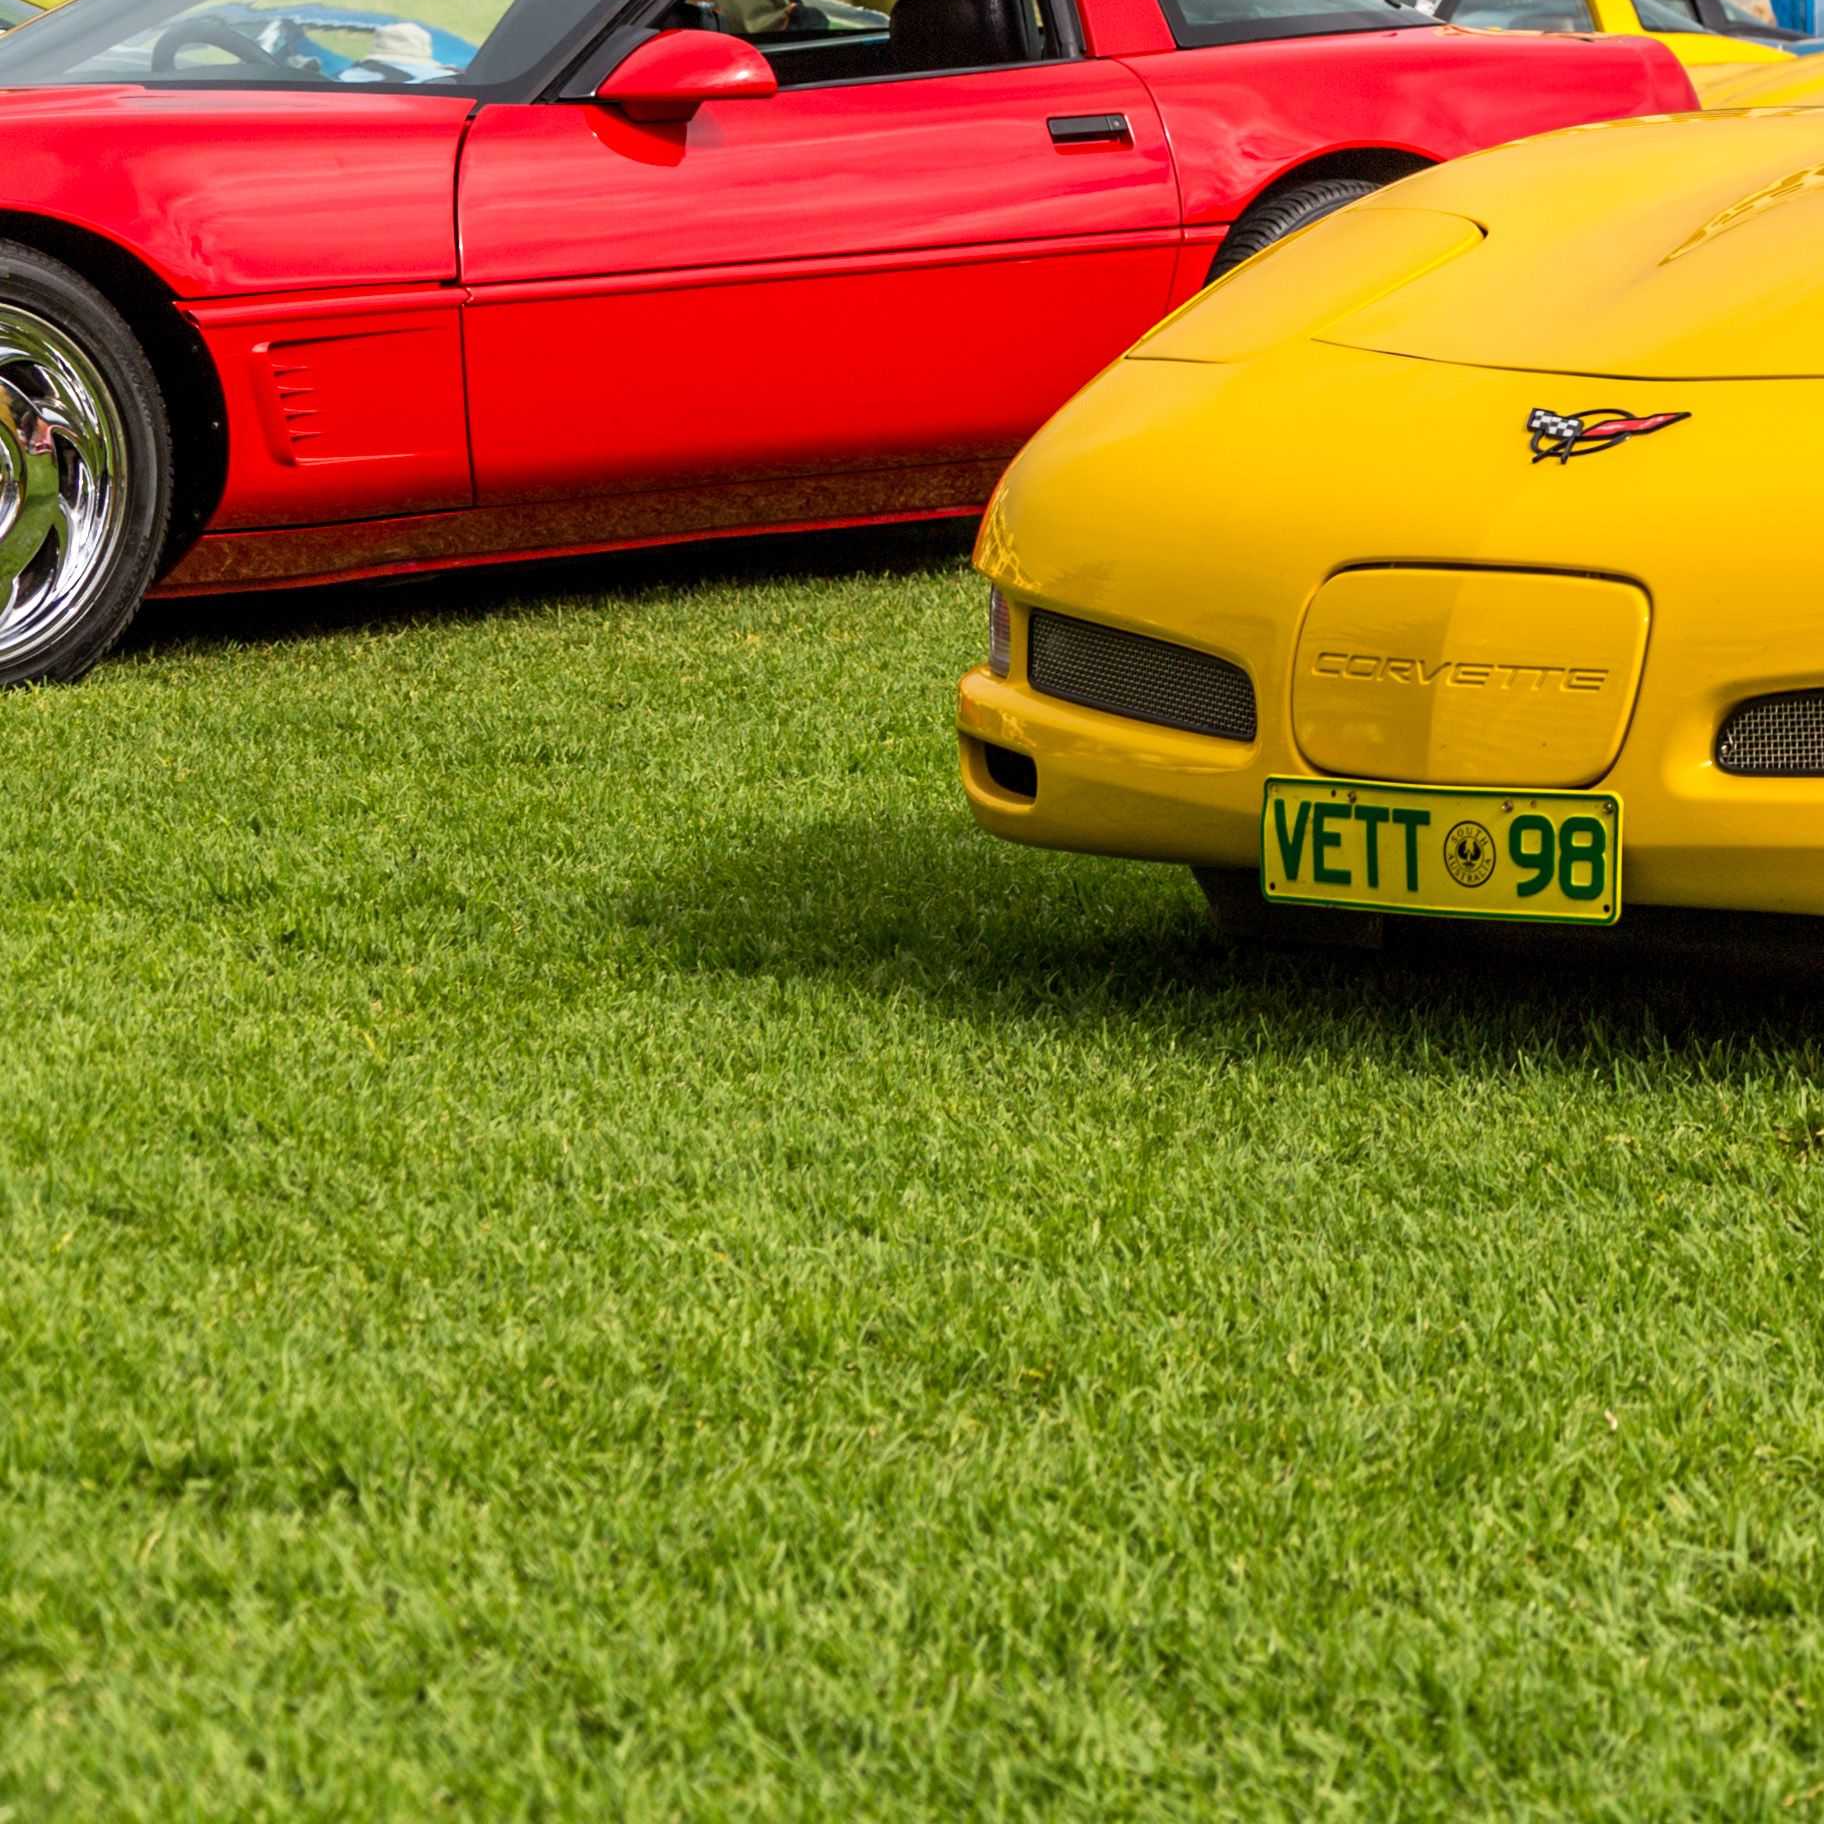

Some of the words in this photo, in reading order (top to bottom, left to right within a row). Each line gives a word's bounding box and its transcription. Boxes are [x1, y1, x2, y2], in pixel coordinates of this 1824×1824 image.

[1311, 651, 1610, 693] CORVETTE
[1273, 798, 1431, 893] VETT
[1507, 813, 1608, 901] 98
[1450, 826, 1489, 847] SOUTH
[1448, 854, 1492, 882] AUSTRALIA
